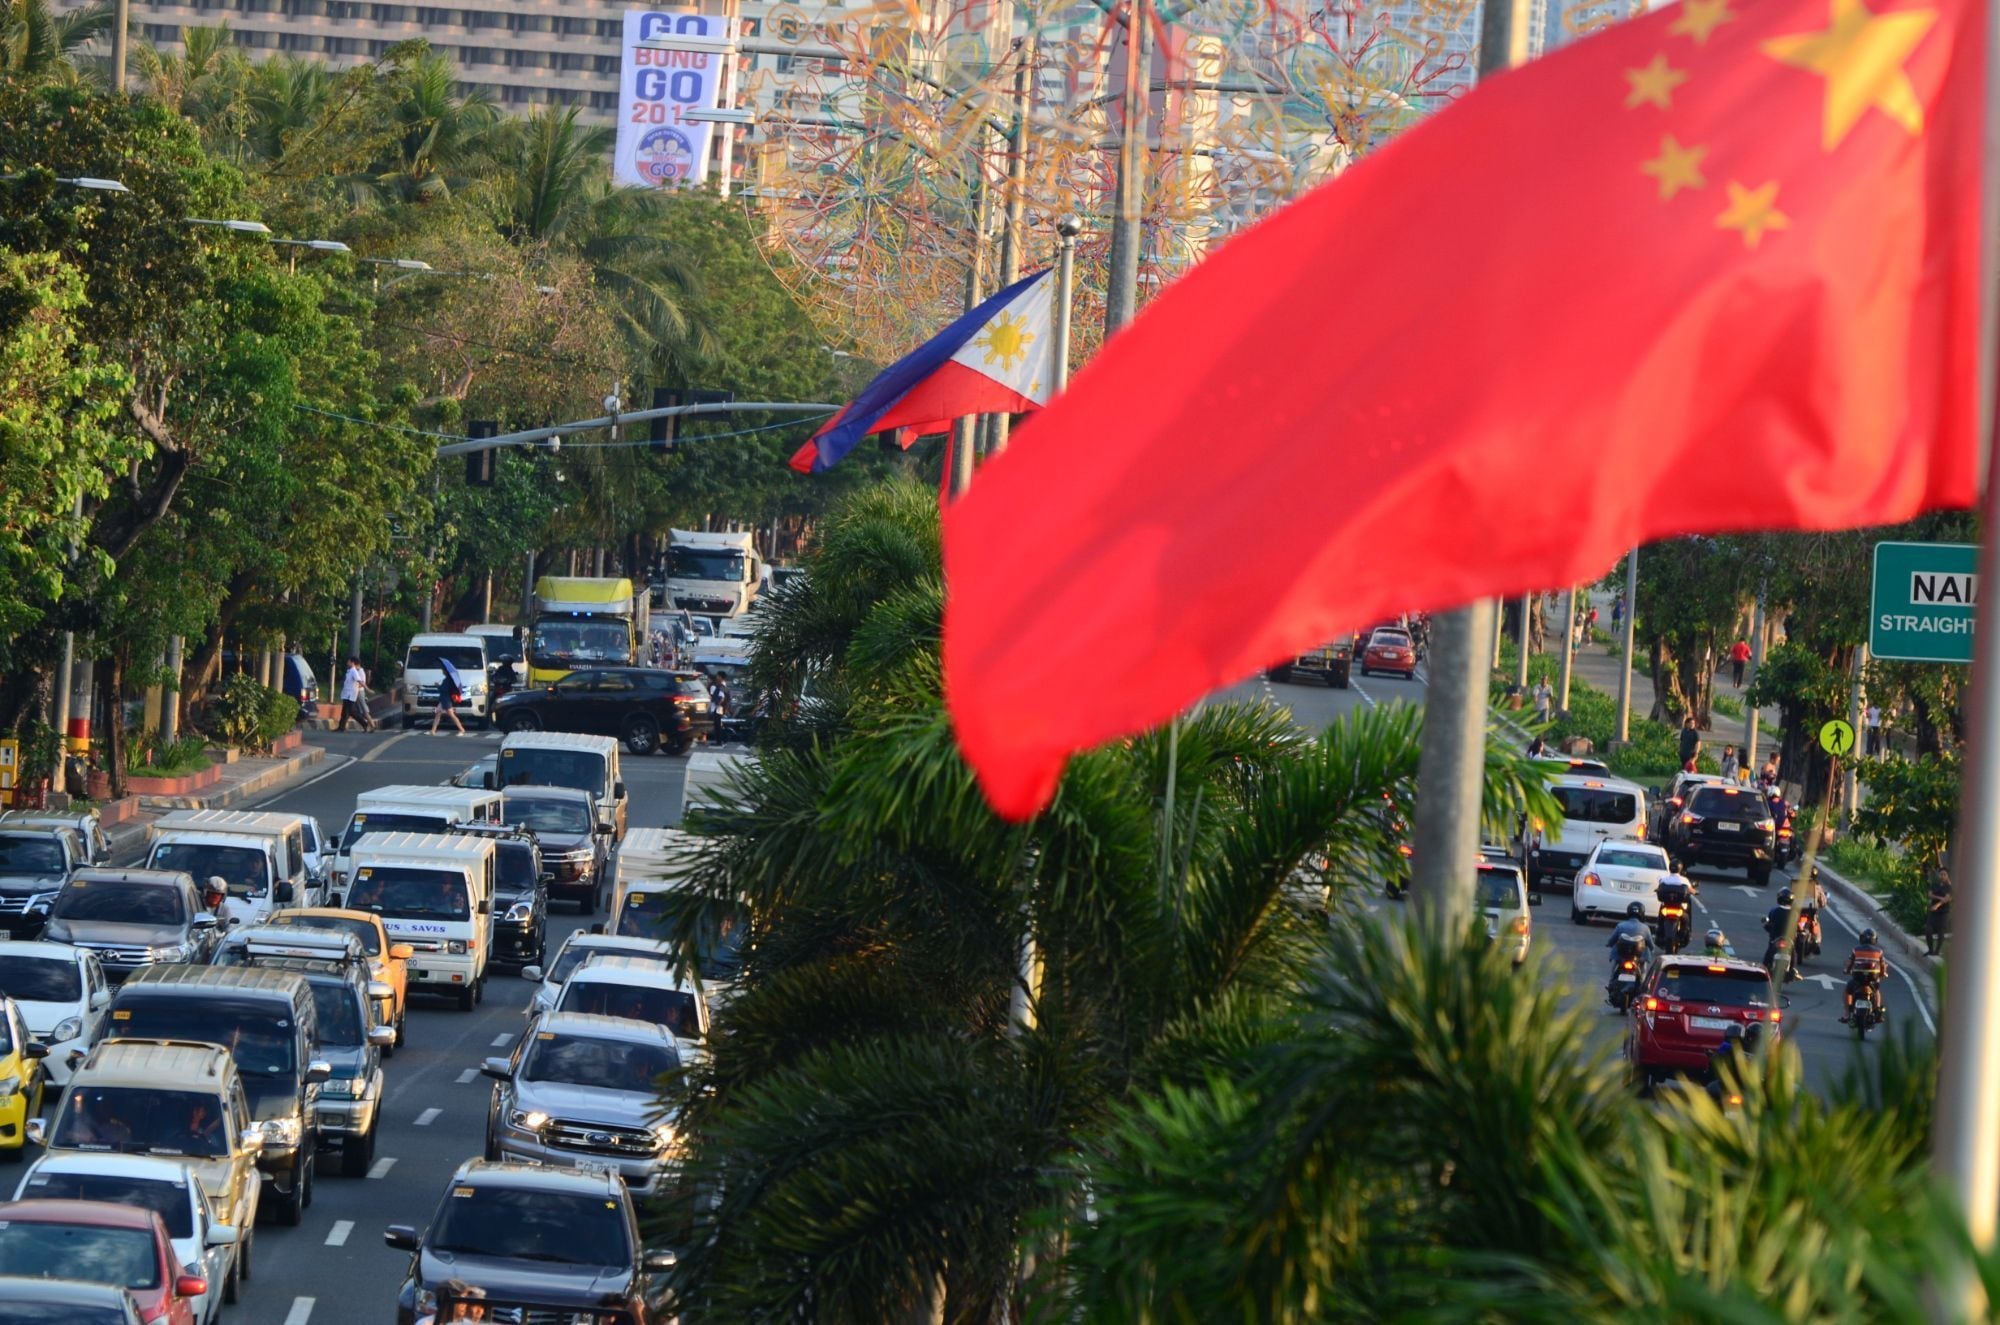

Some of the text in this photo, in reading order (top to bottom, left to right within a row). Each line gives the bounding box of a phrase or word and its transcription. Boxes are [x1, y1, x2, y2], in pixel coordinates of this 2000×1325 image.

[639, 13, 708, 42] GO
[635, 68, 703, 104] GO
[650, 162, 677, 177] GO
[1913, 574, 1979, 604] NAI
[1880, 614, 1976, 635] STRAIGHT
[411, 924, 447, 933] SAVES
